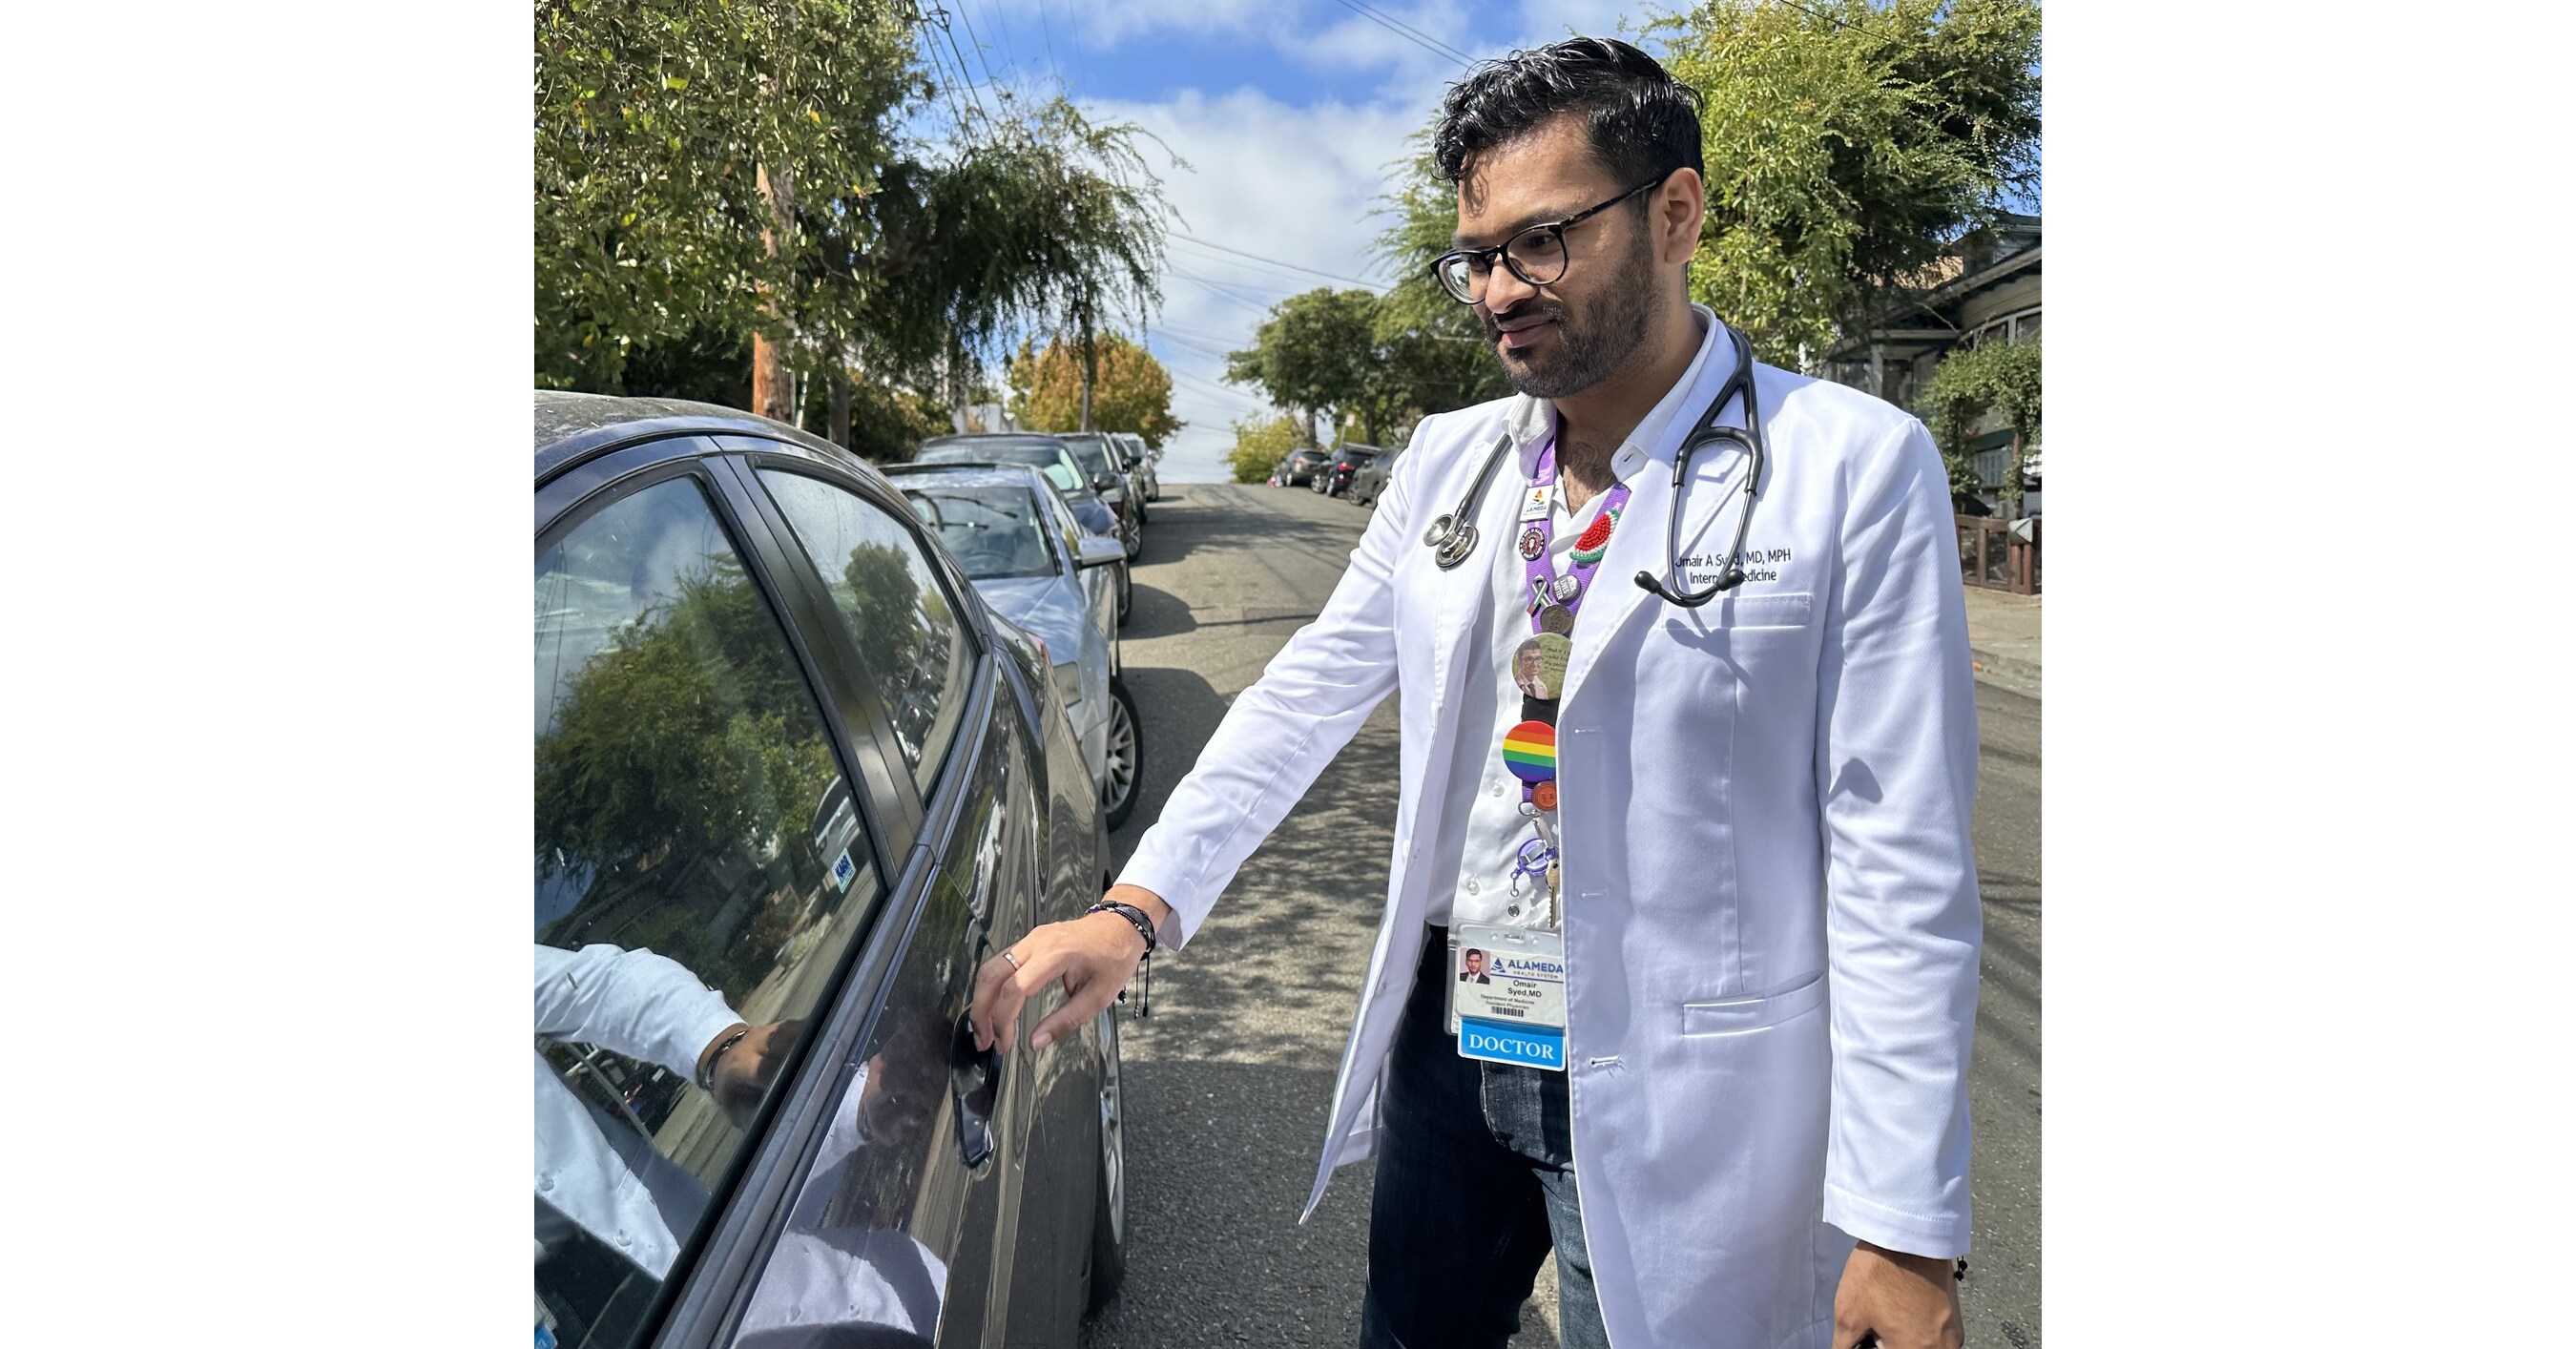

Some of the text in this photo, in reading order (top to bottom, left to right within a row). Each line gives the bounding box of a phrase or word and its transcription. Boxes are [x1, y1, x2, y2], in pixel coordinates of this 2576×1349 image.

[1706, 553, 1714, 567] A
[1715, 551, 1744, 567] Syd,
[1746, 550, 1765, 565] MD,
[1768, 548, 1791, 563] MPH
[1690, 569, 1777, 585] Intern edicine
[1507, 959, 1564, 974] ALAMEDA
[1513, 979, 1538, 989] Omair
[1468, 1033, 1555, 1060] DOCTOR
